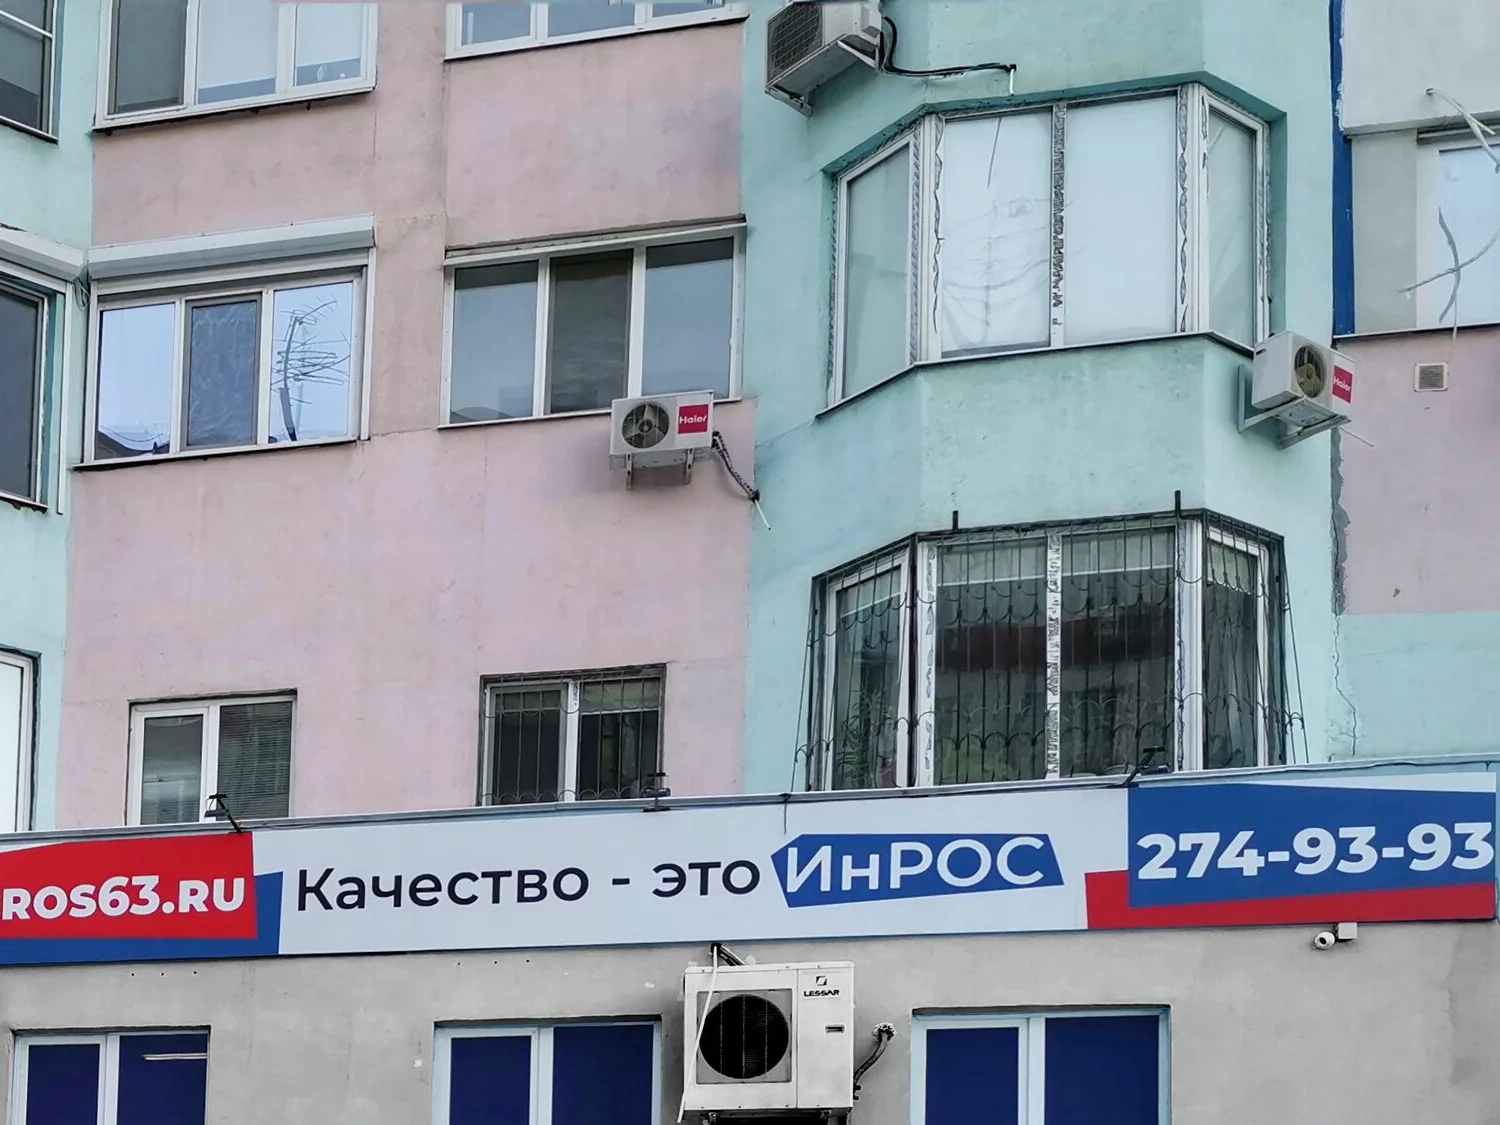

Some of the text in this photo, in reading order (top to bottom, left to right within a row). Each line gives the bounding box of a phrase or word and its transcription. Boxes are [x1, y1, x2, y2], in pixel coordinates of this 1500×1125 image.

[678, 415, 707, 424] Haier
[1136, 821, 1495, 879] 274-93-93
[297, 861, 589, 912] Качество
[652, 860, 760, 898] это
[786, 838, 1045, 892] ИнРОС
[804, 989, 840, 997] LESSAR
